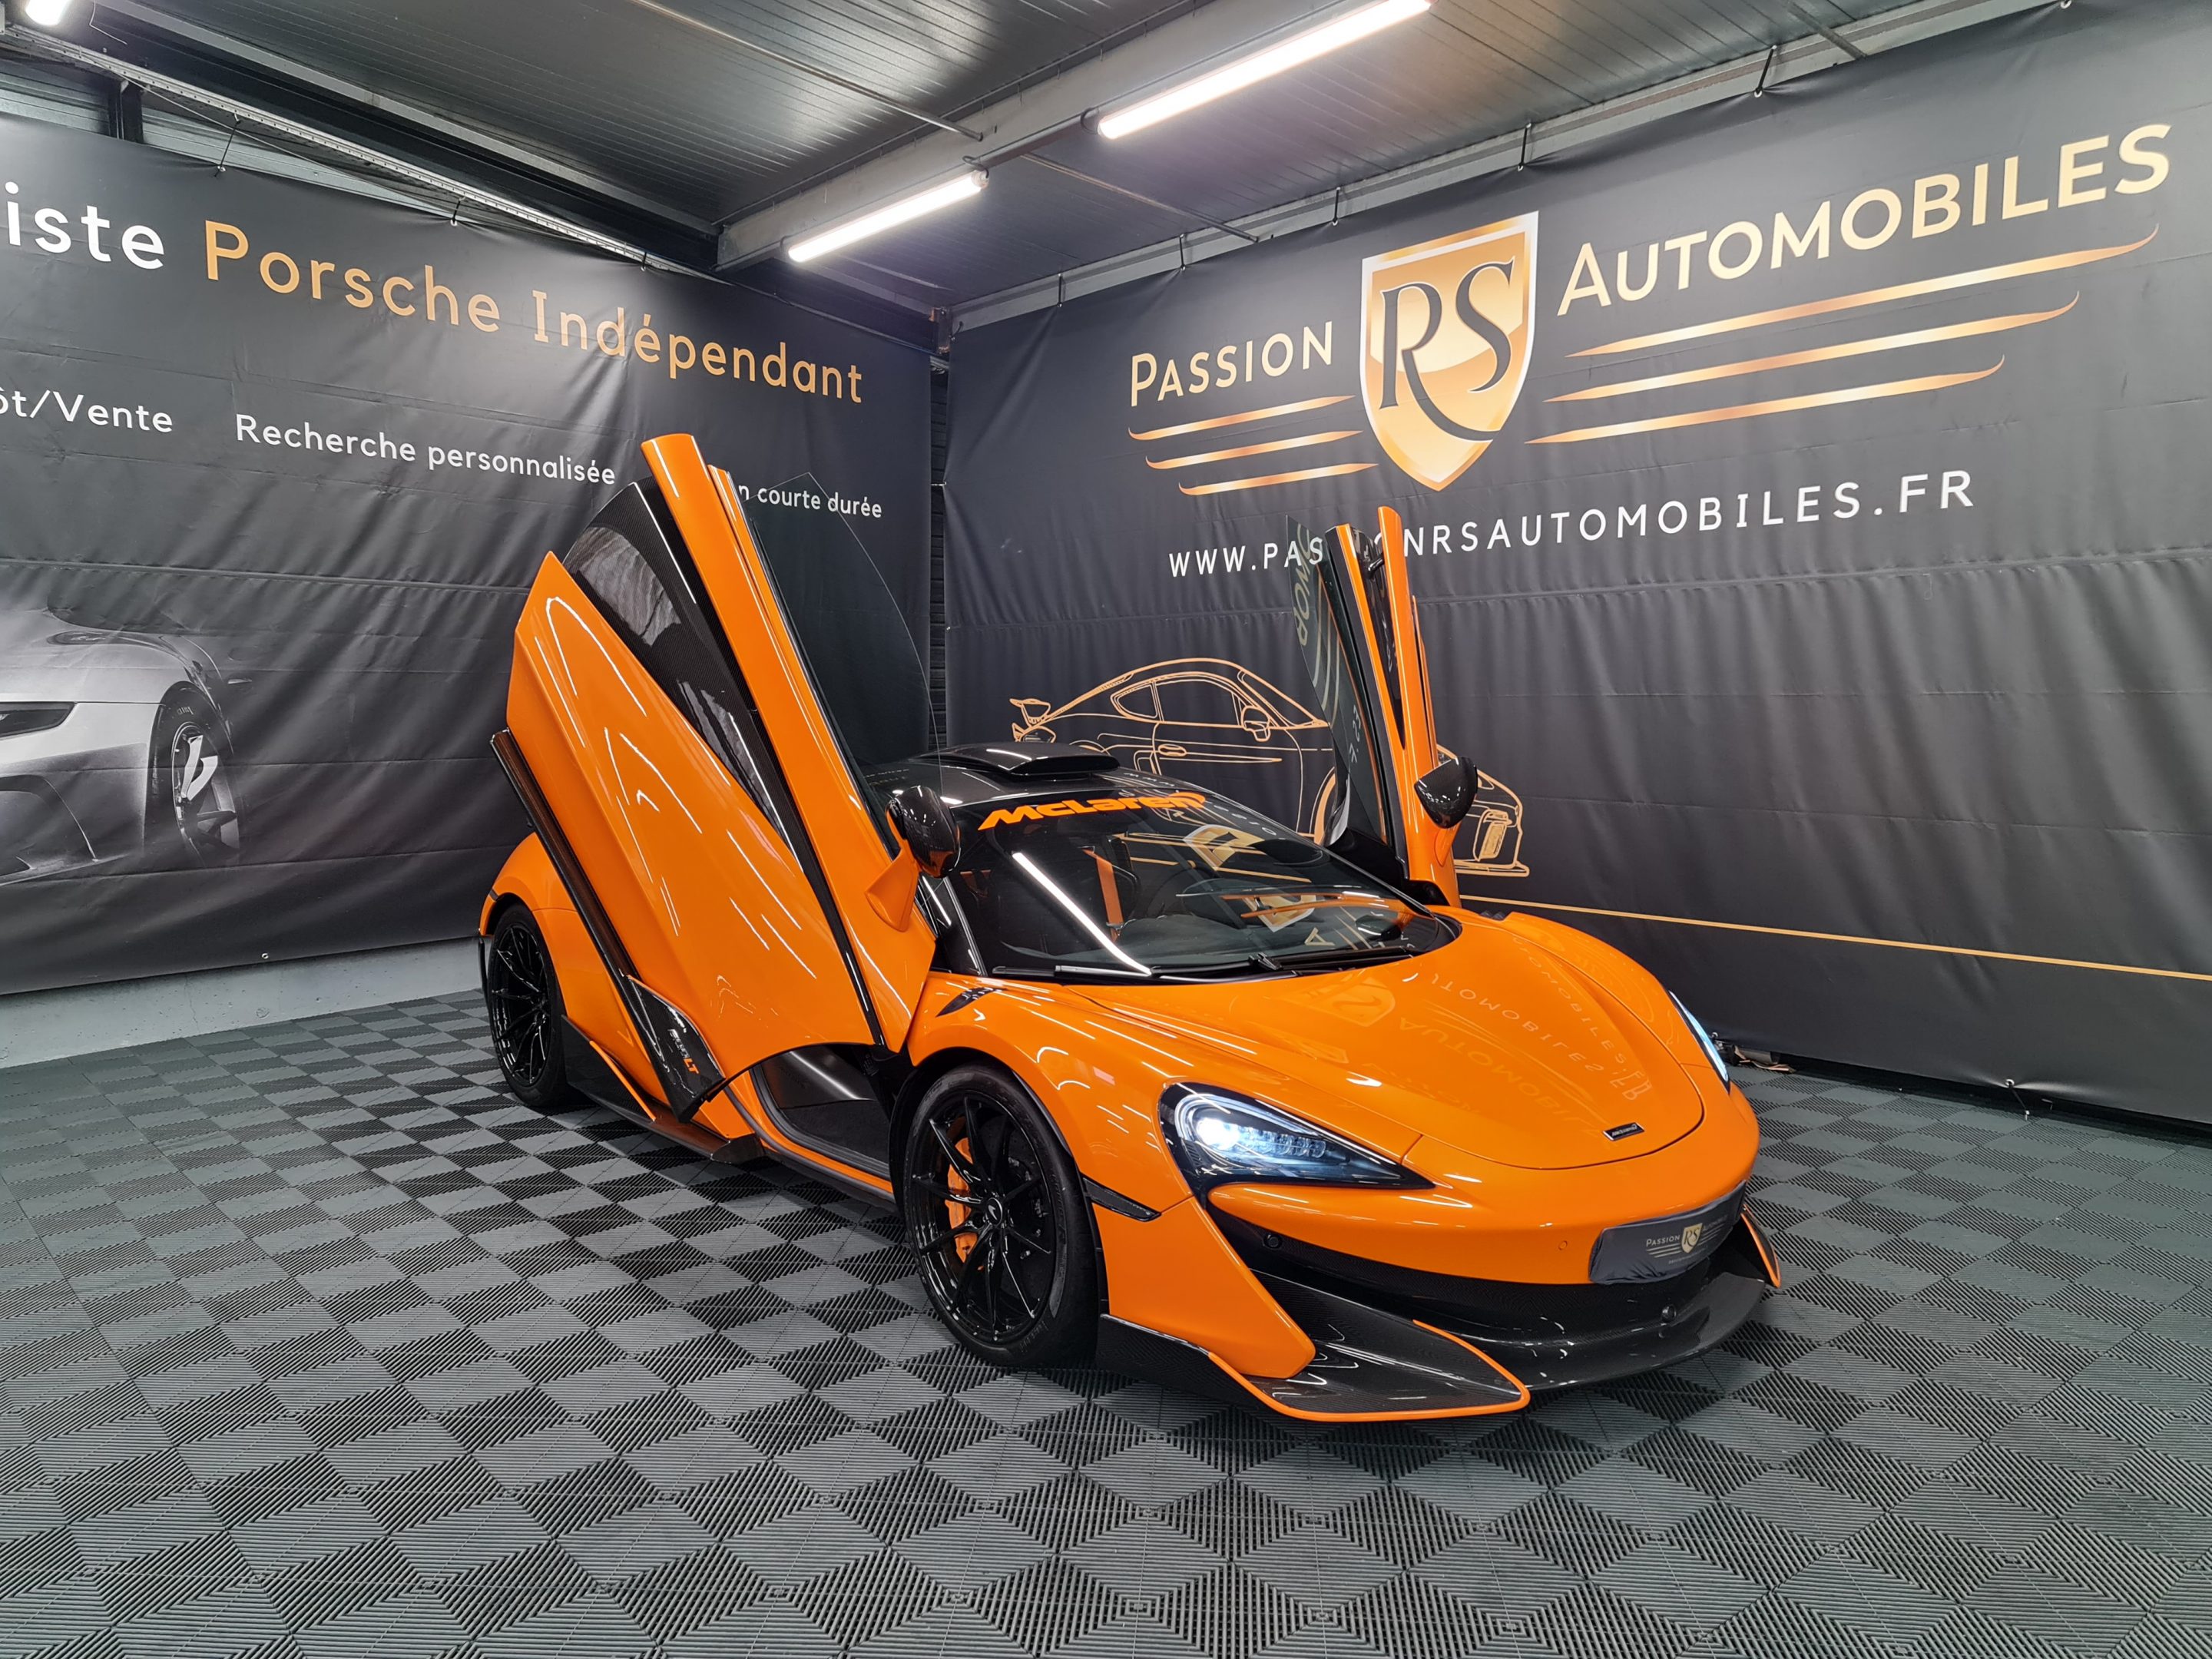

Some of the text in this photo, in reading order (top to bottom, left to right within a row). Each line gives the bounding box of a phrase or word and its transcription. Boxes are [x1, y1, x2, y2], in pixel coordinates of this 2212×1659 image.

[5, 181, 862, 403] iste Porsche Indépendant
[1131, 124, 2171, 442] PASSION RS AUTOMOBILES
[236, 413, 615, 485] Recherche personnalisée
[757, 488, 821, 510] courte
[827, 492, 882, 518] durée
[1168, 469, 1974, 578] WWW.PASNRSAUTOMOBILES.FR
[977, 792, 1206, 830] McLaren
[1646, 1234, 1681, 1247] PASSION
